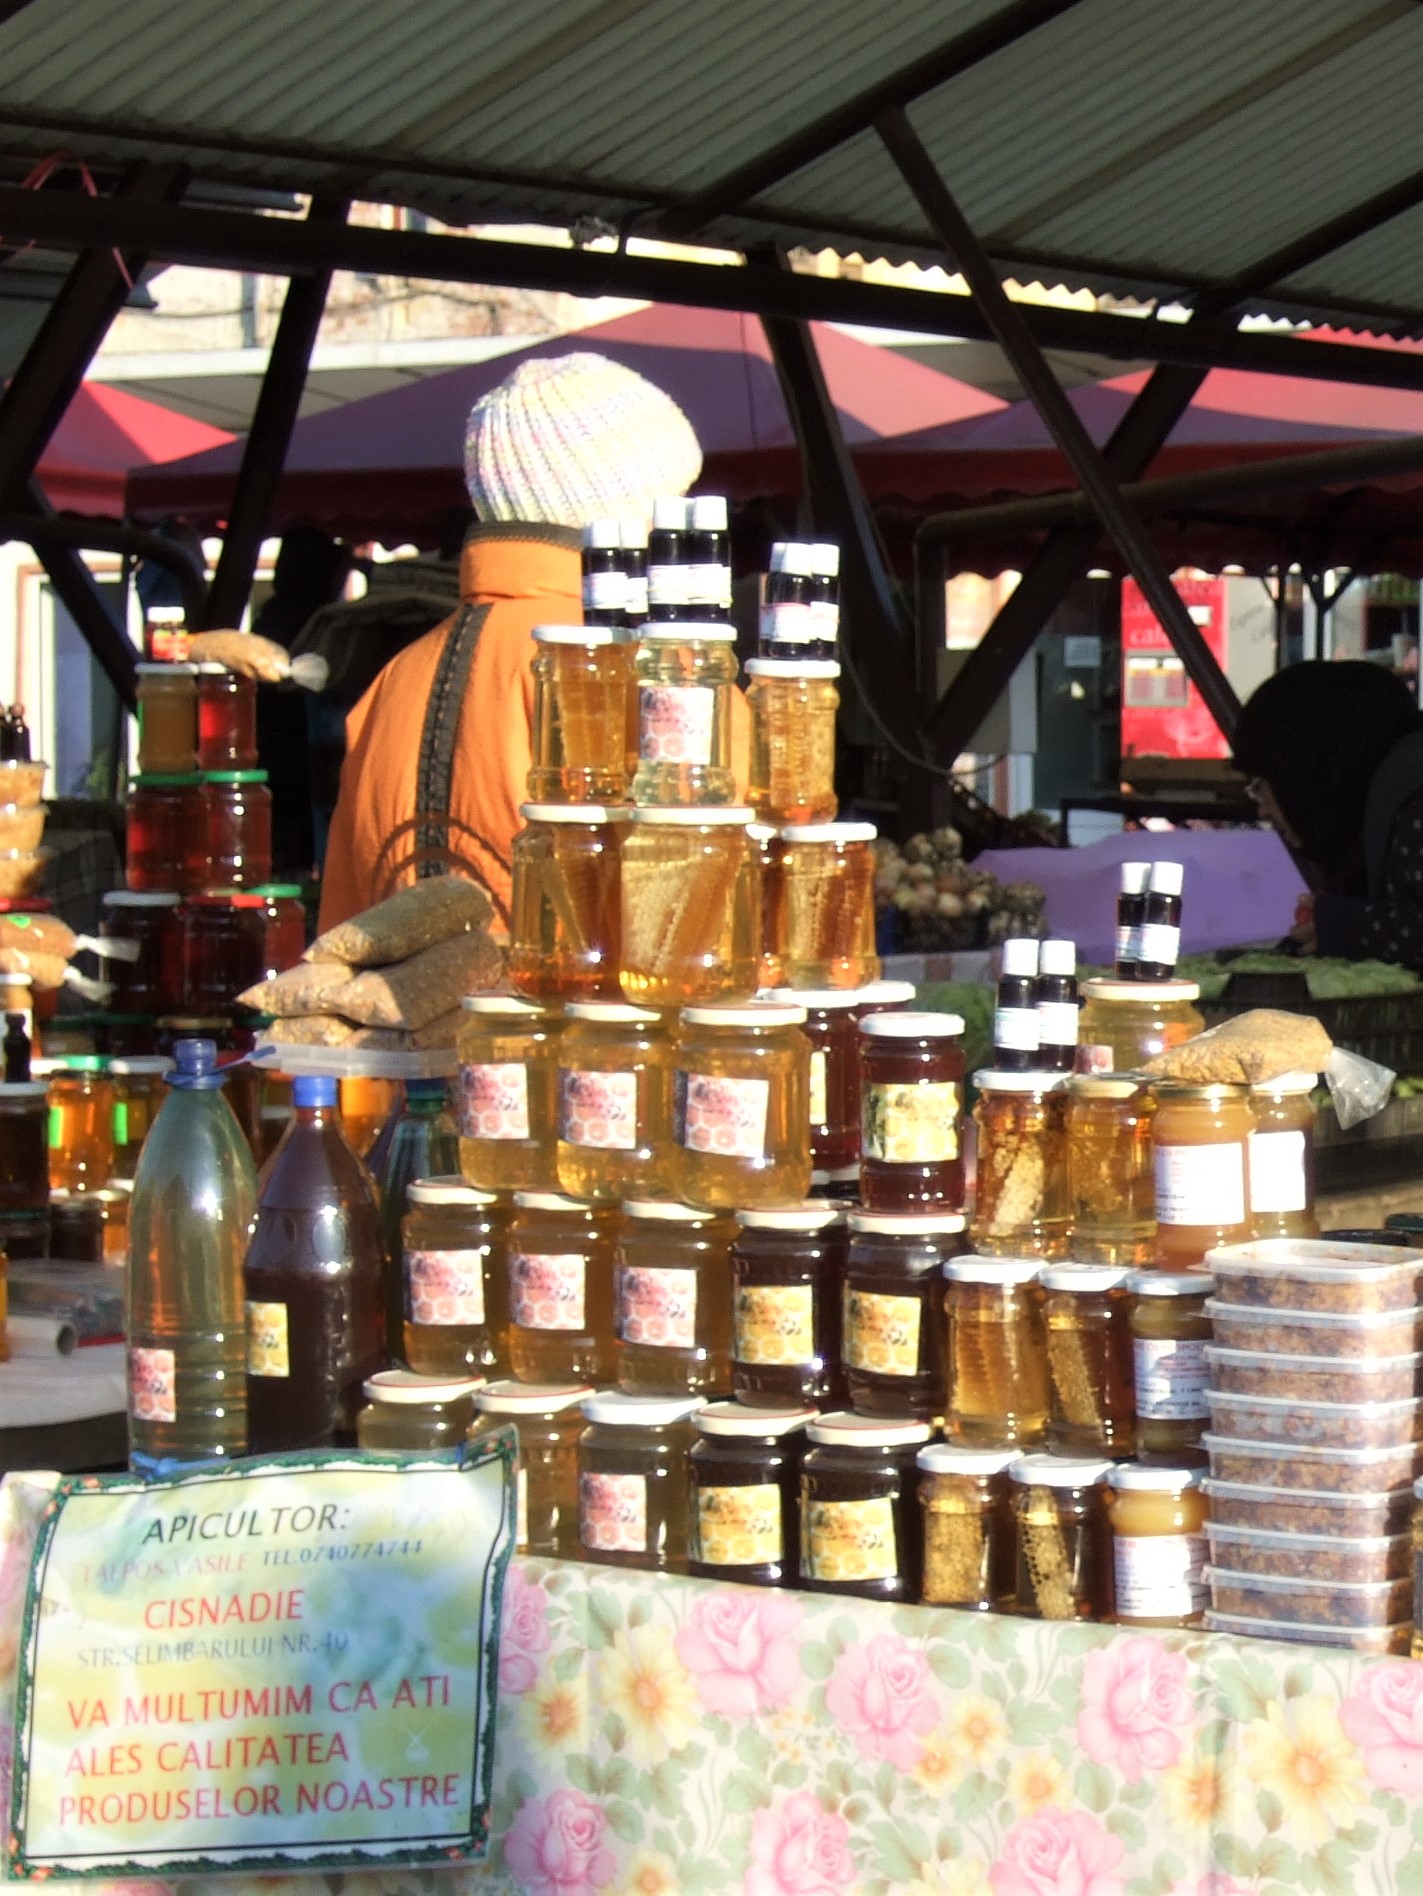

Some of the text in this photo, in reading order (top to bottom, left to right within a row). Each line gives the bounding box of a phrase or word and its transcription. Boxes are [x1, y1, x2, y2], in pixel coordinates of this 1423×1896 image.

[142, 1503, 350, 1545] APICULTOR:
[173, 1552, 248, 1577] VASILE
[144, 1588, 304, 1630] CISNADIE
[67, 1675, 451, 1730] VA MULTUMIM CA ATI
[65, 1732, 349, 1778] ALES CALITATEA
[59, 1773, 460, 1826] PRODUSELOR NOASTRE
